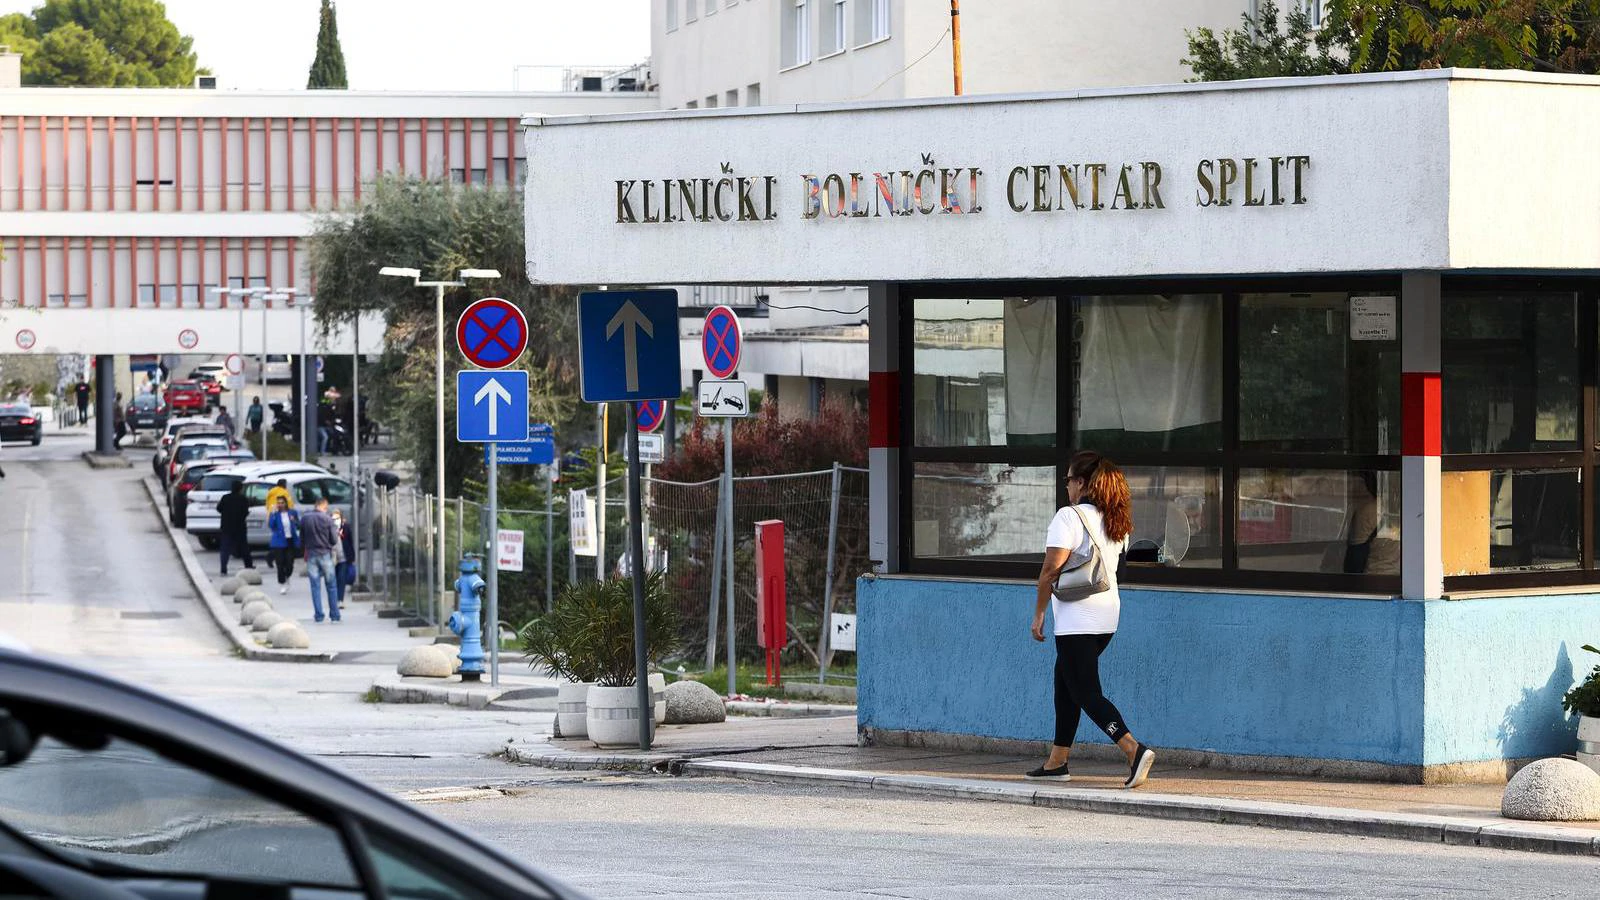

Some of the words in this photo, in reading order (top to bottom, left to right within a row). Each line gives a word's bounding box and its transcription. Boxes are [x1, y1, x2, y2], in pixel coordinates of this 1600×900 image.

[615, 161, 778, 224] KLINIČKI
[801, 153, 983, 219] BOLNIČKI
[1006, 161, 1166, 213] CENTAR
[1196, 155, 1311, 207] SPLIT
